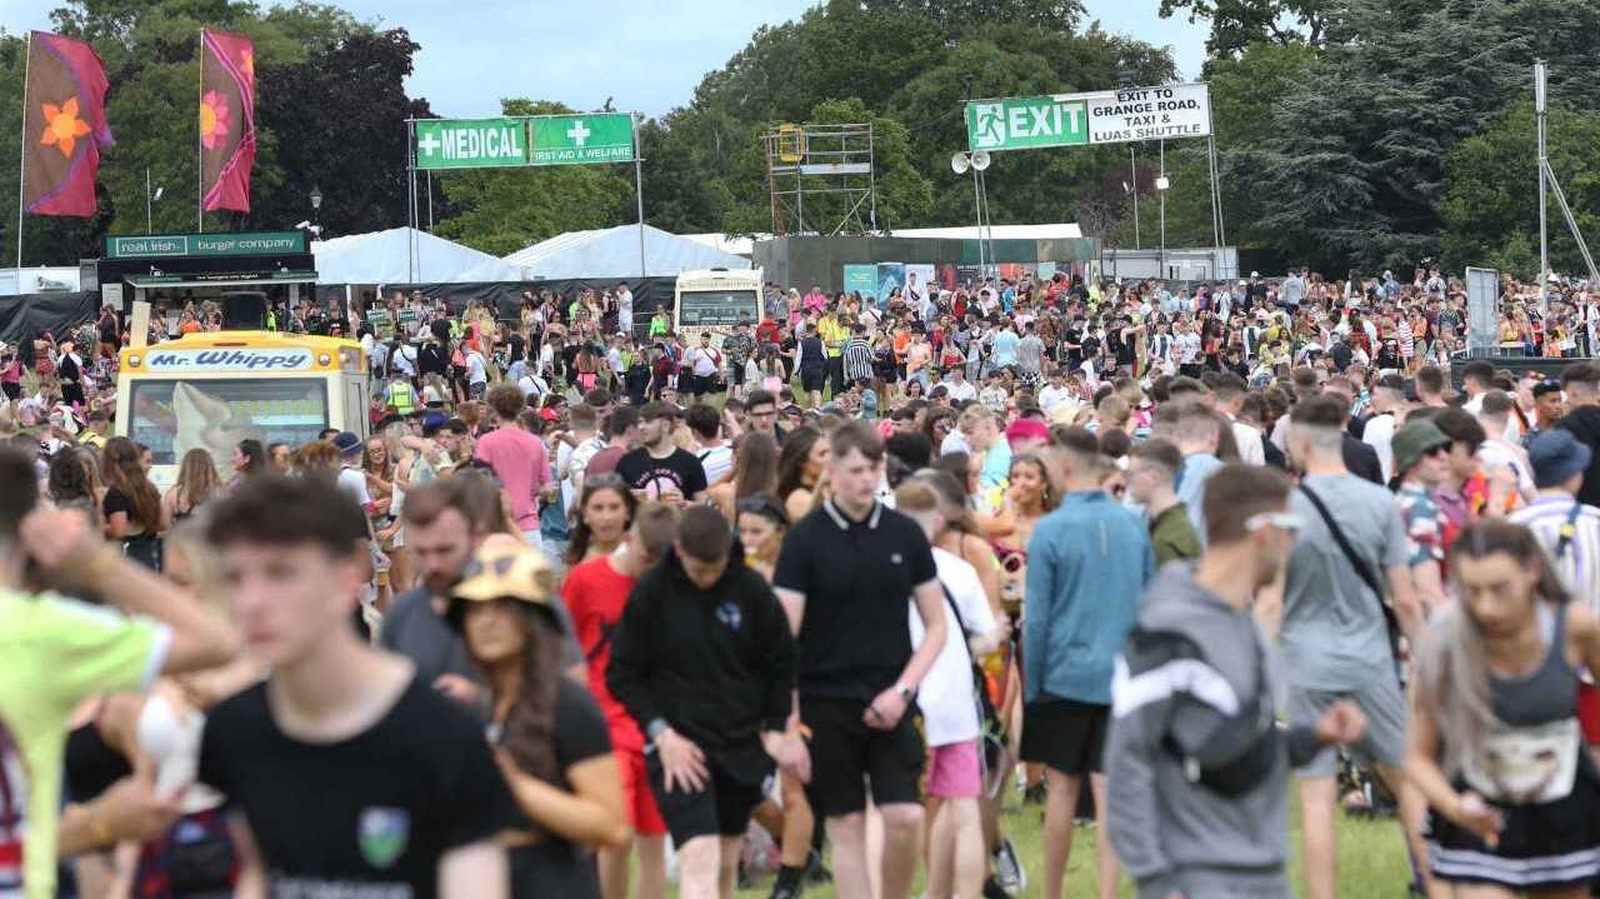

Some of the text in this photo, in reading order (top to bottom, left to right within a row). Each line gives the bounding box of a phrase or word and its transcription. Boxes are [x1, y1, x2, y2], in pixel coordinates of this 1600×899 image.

[1118, 88, 1173, 102] EXIT TO
[1093, 103, 1153, 117] GRANGE
[1010, 104, 1083, 137] EXIT
[1124, 114, 1171, 127] TAXI &
[1094, 123, 1201, 142] LUAS SHUTTLE
[441, 127, 523, 160] MEDICAL
[558, 150, 575, 160] AID
[586, 147, 631, 158] WELFARE
[121, 239, 148, 252] real
[198, 238, 295, 251] burger company
[151, 351, 307, 368] Mr. Whippy
